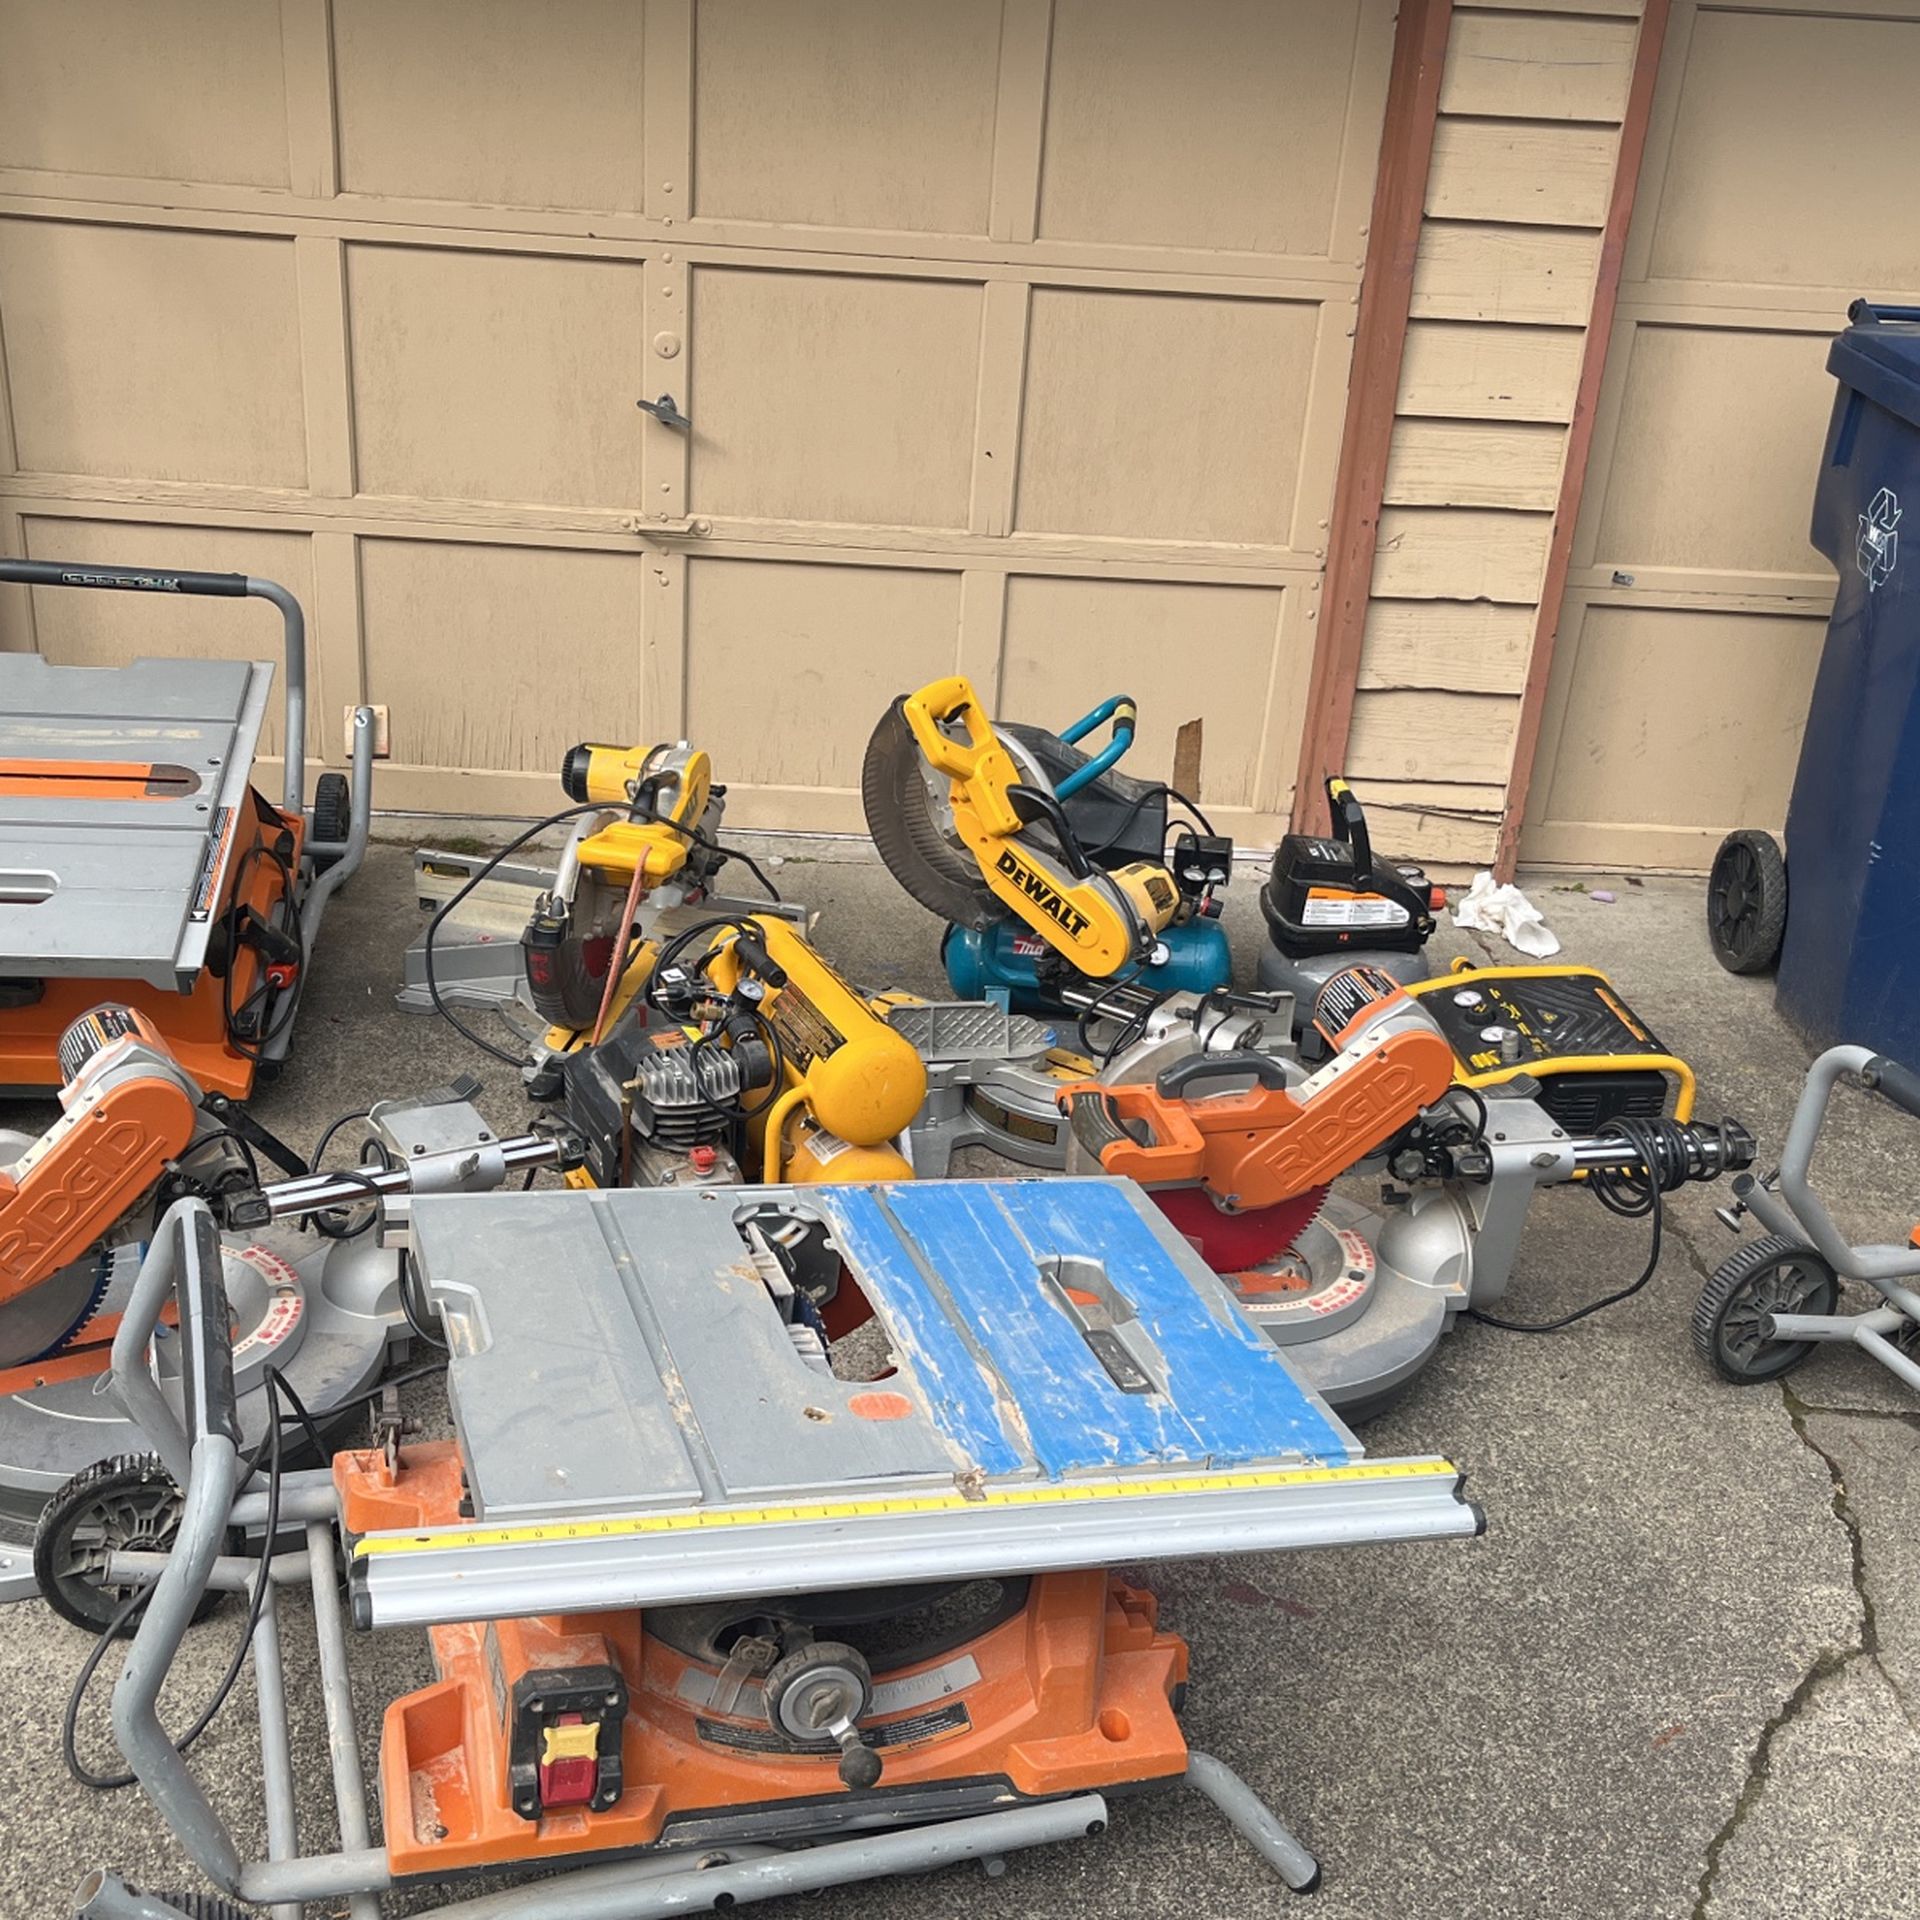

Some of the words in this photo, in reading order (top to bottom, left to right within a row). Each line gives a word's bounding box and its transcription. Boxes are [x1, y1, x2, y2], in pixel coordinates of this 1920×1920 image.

[996, 850, 1089, 937] DEWALT
[1265, 1064, 1414, 1186] RIDGID
[0, 1120, 147, 1276] RIDGID
